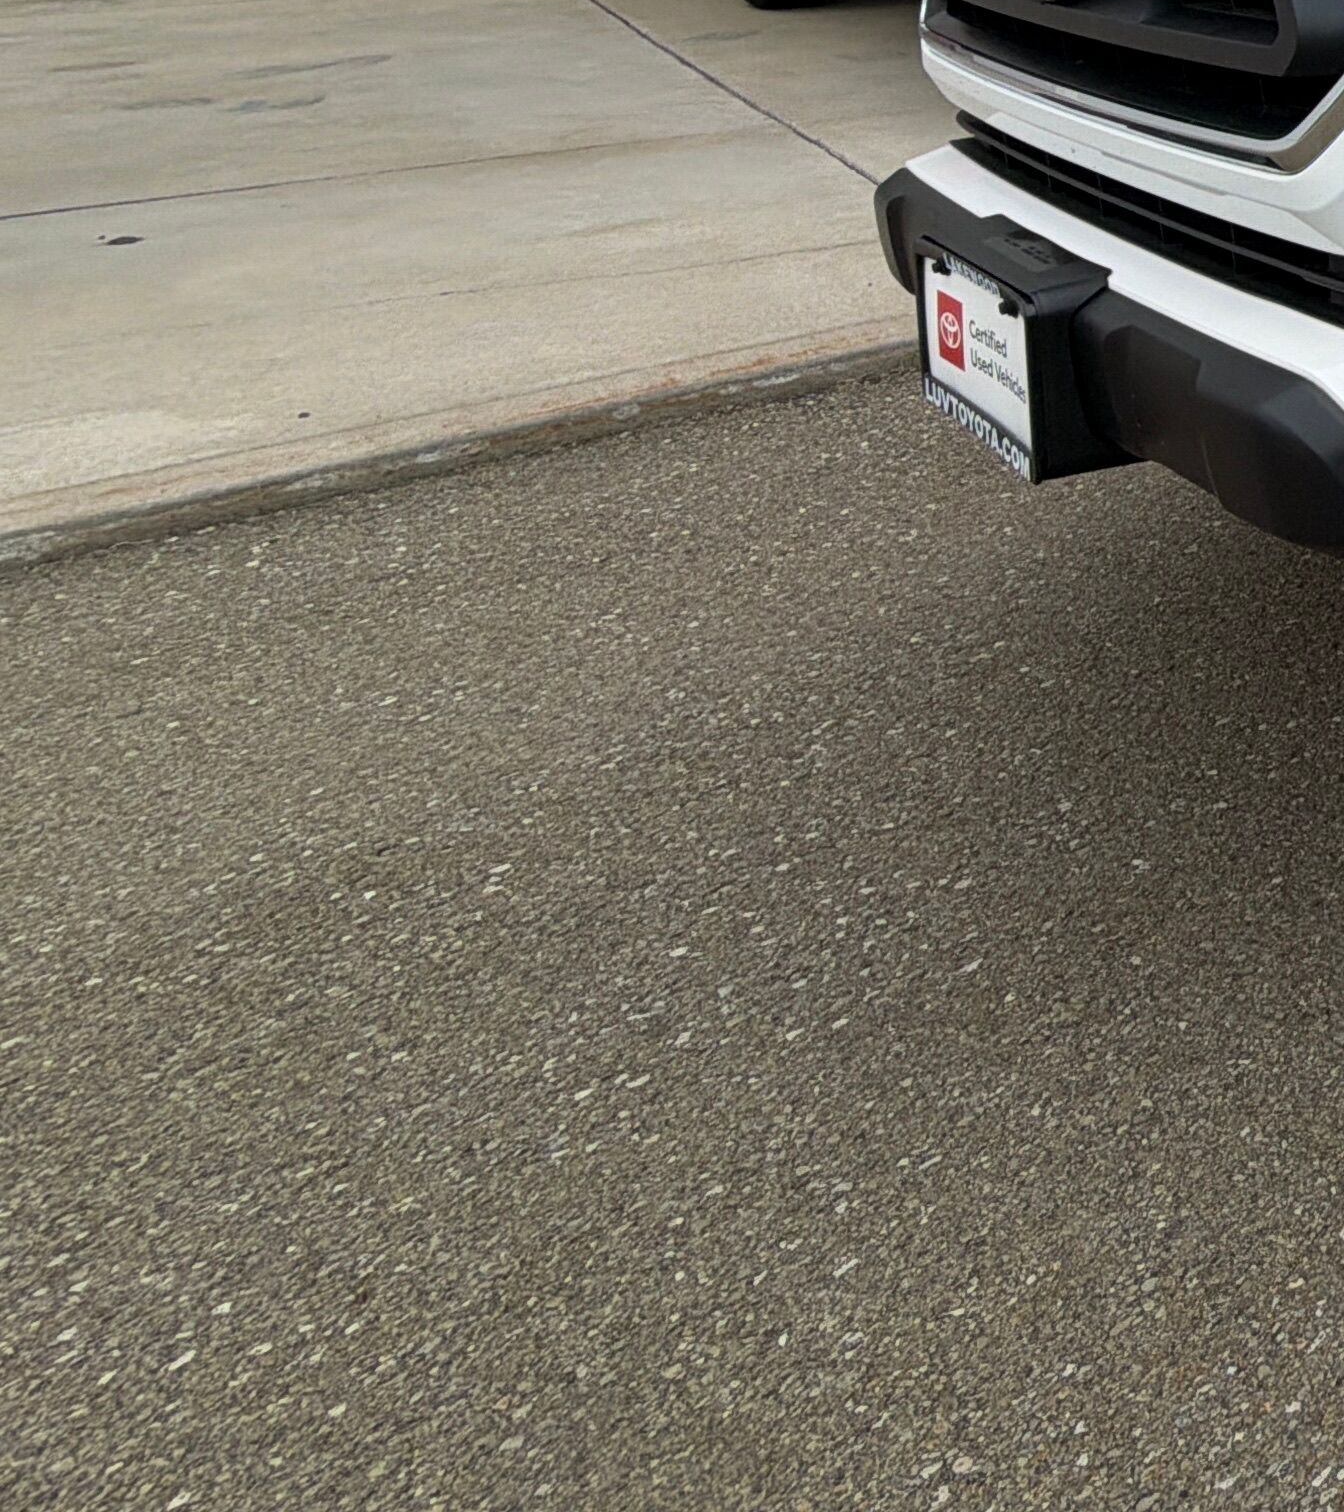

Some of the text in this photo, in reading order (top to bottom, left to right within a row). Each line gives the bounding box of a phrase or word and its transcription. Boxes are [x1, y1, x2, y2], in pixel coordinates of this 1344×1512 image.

[968, 319, 1008, 359] Certified
[969, 347, 1027, 405] Used Vehicles
[925, 377, 1031, 482] LUVTOYOTA.COM
